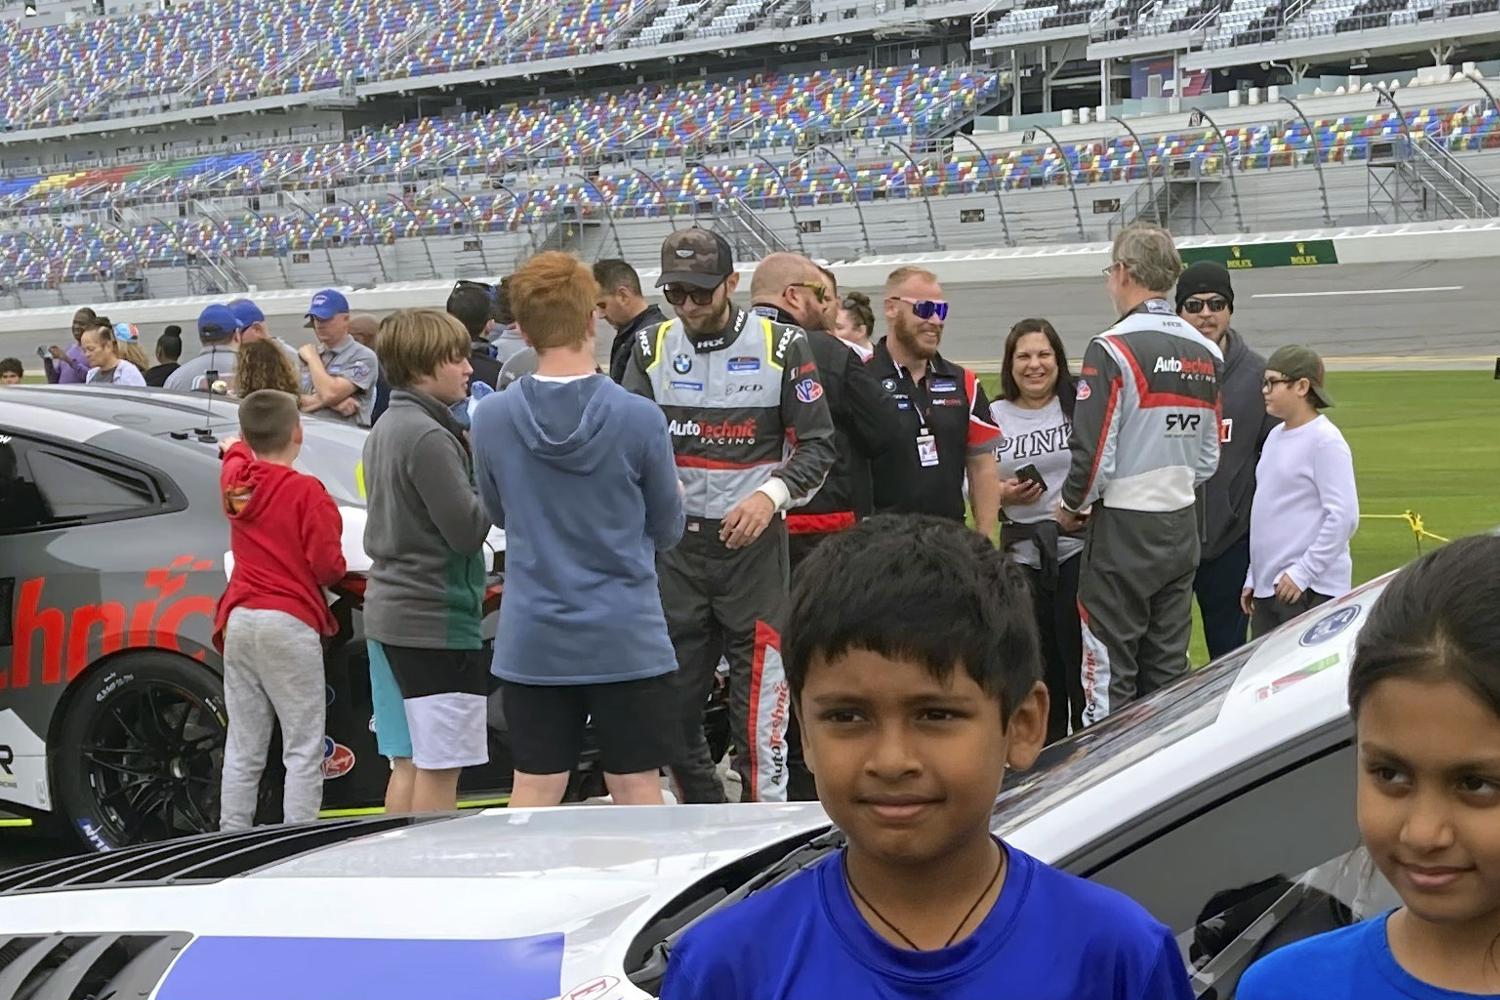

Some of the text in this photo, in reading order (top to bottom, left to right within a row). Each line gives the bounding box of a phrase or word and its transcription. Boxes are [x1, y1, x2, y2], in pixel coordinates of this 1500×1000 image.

[697, 338, 725, 350] HRX
[776, 328, 795, 359] HRX
[700, 437, 756, 446] RACING
[0, 576, 217, 692] hnic
